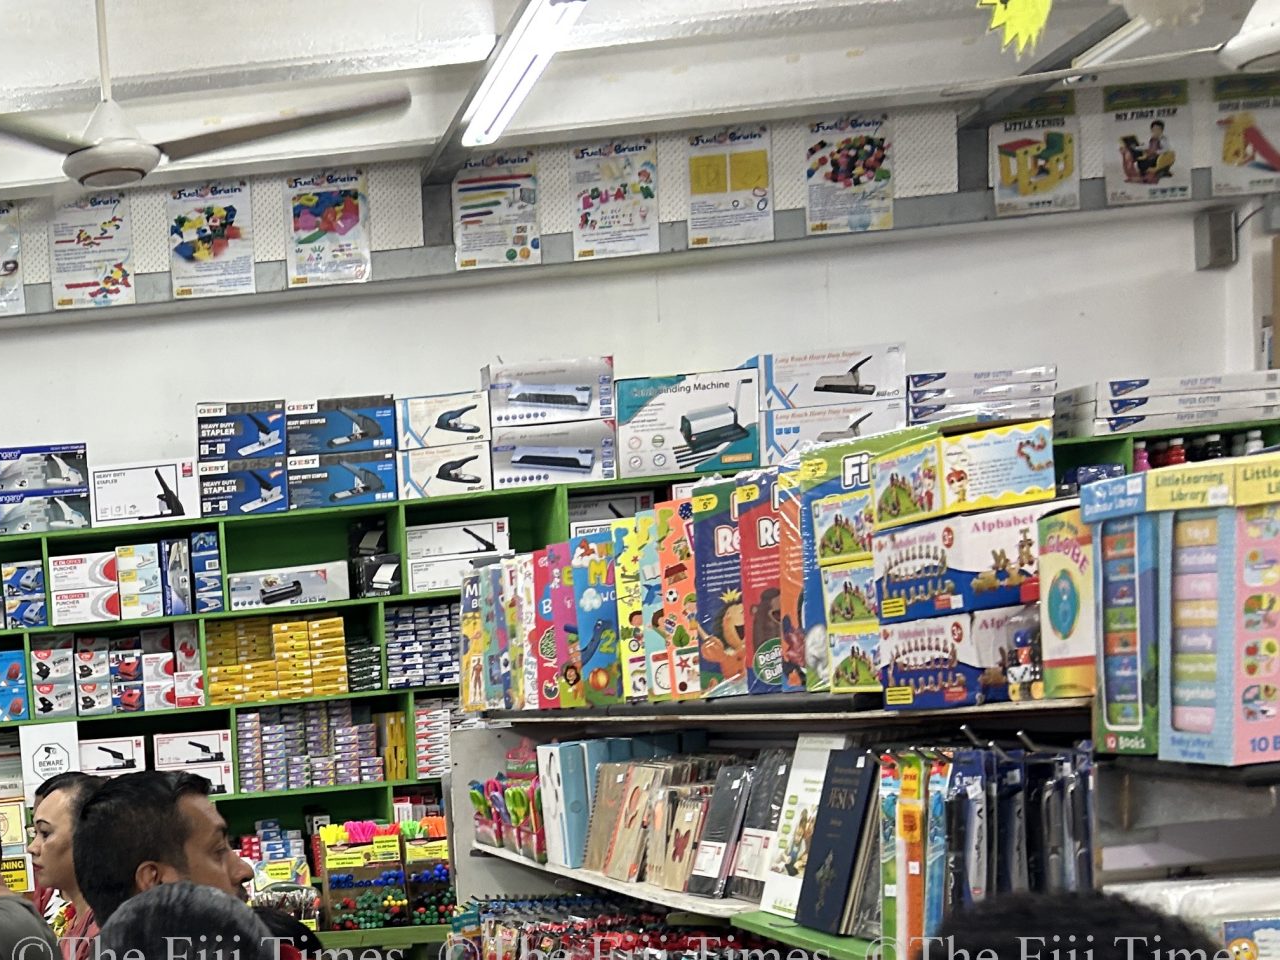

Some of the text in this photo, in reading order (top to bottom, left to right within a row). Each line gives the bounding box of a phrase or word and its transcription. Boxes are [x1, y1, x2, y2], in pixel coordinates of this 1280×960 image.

[1115, 113, 1128, 121] MY
[326, 175, 358, 184] Brain
[210, 185, 242, 196] Brain
[693, 381, 730, 392] Machine
[287, 403, 315, 412] GEST
[201, 428, 235, 436] STAPLER
[842, 453, 870, 489] Fi
[1243, 466, 1276, 482] Little
[1155, 472, 1223, 487] Little Learning
[203, 485, 237, 494] STAPLER
[1171, 490, 1205, 502] Library
[971, 512, 1034, 533] Alphabet
[578, 527, 597, 535] HEAVY
[943, 530, 954, 543] 3+
[1046, 532, 1088, 575] GLOBE
[952, 626, 963, 638] 3+
[601, 629, 616, 653] 2
[1106, 736, 1116, 749] 10
[1250, 737, 1268, 753] 10
[39, 760, 64, 768] BEWARE
